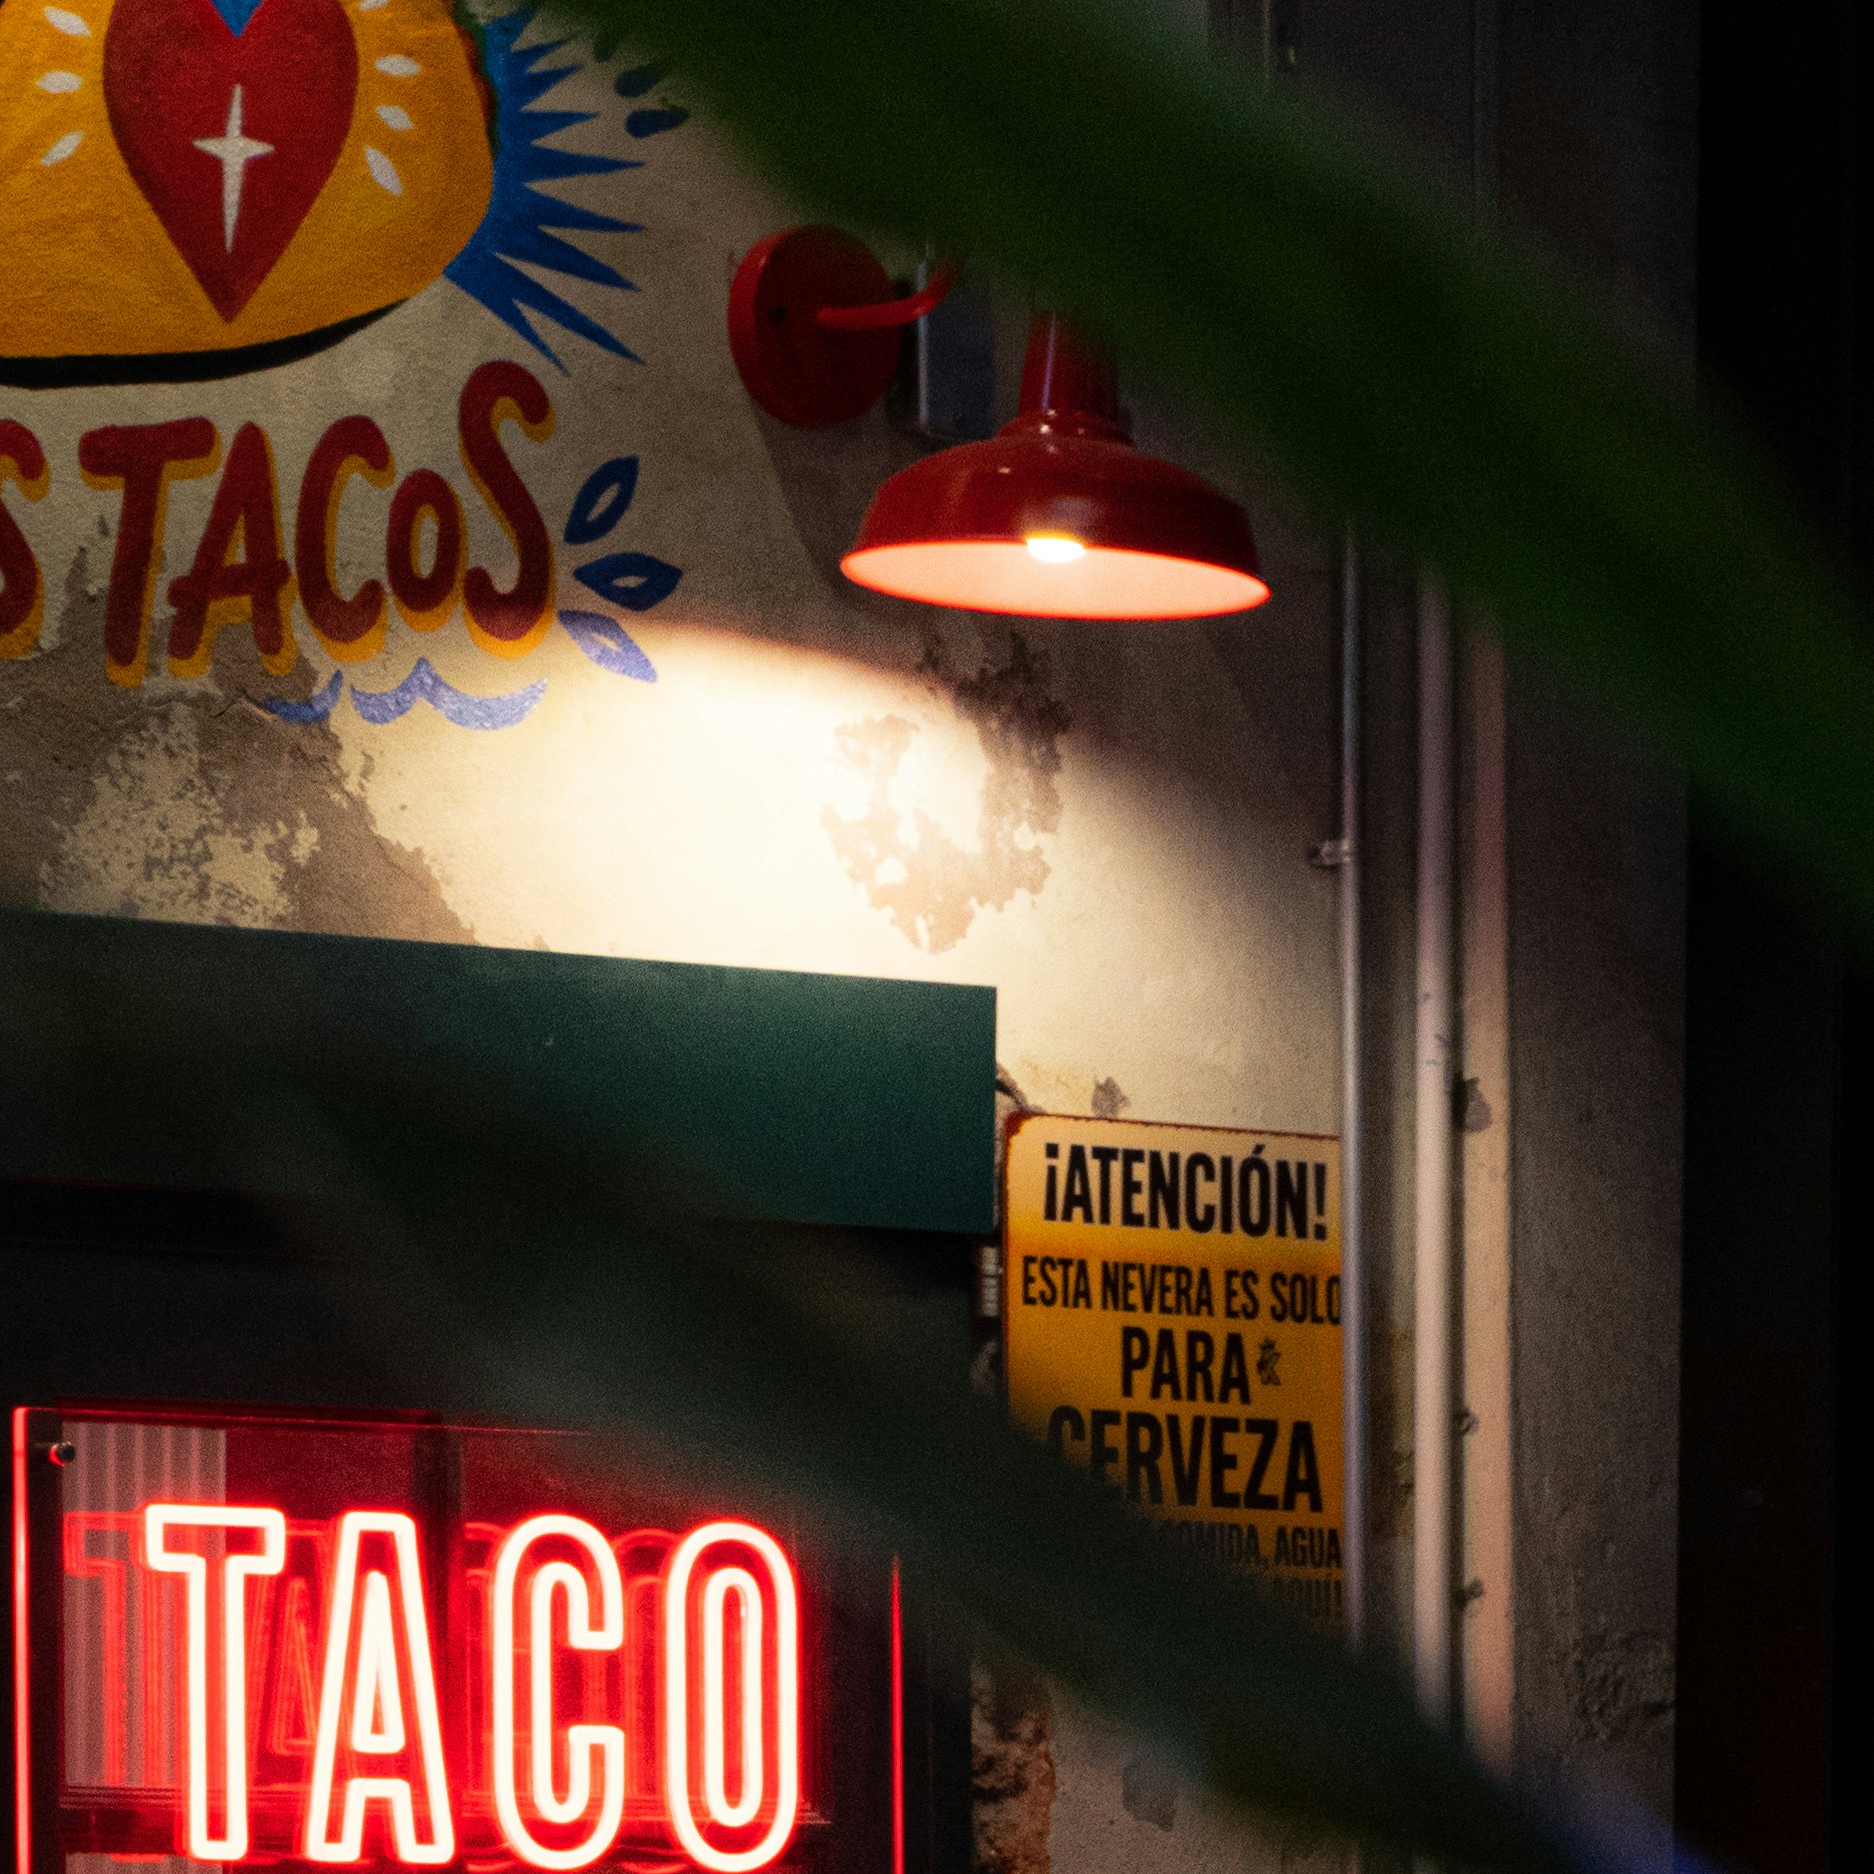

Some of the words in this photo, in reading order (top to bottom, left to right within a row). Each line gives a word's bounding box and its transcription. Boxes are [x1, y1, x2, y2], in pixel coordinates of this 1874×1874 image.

[1043, 1143, 1329, 1240] ¡ATENCIÓN!
[1022, 1255, 1094, 1309] ESTA
[1101, 1262, 1215, 1317] NEVERA
[1225, 1269, 1261, 1322] ES
[1270, 1271, 1342, 1327] SOLO
[1121, 1326, 1252, 1405] PARA
[1046, 1404, 1325, 1513] CERVEZA
[144, 1502, 801, 1874] TACO
